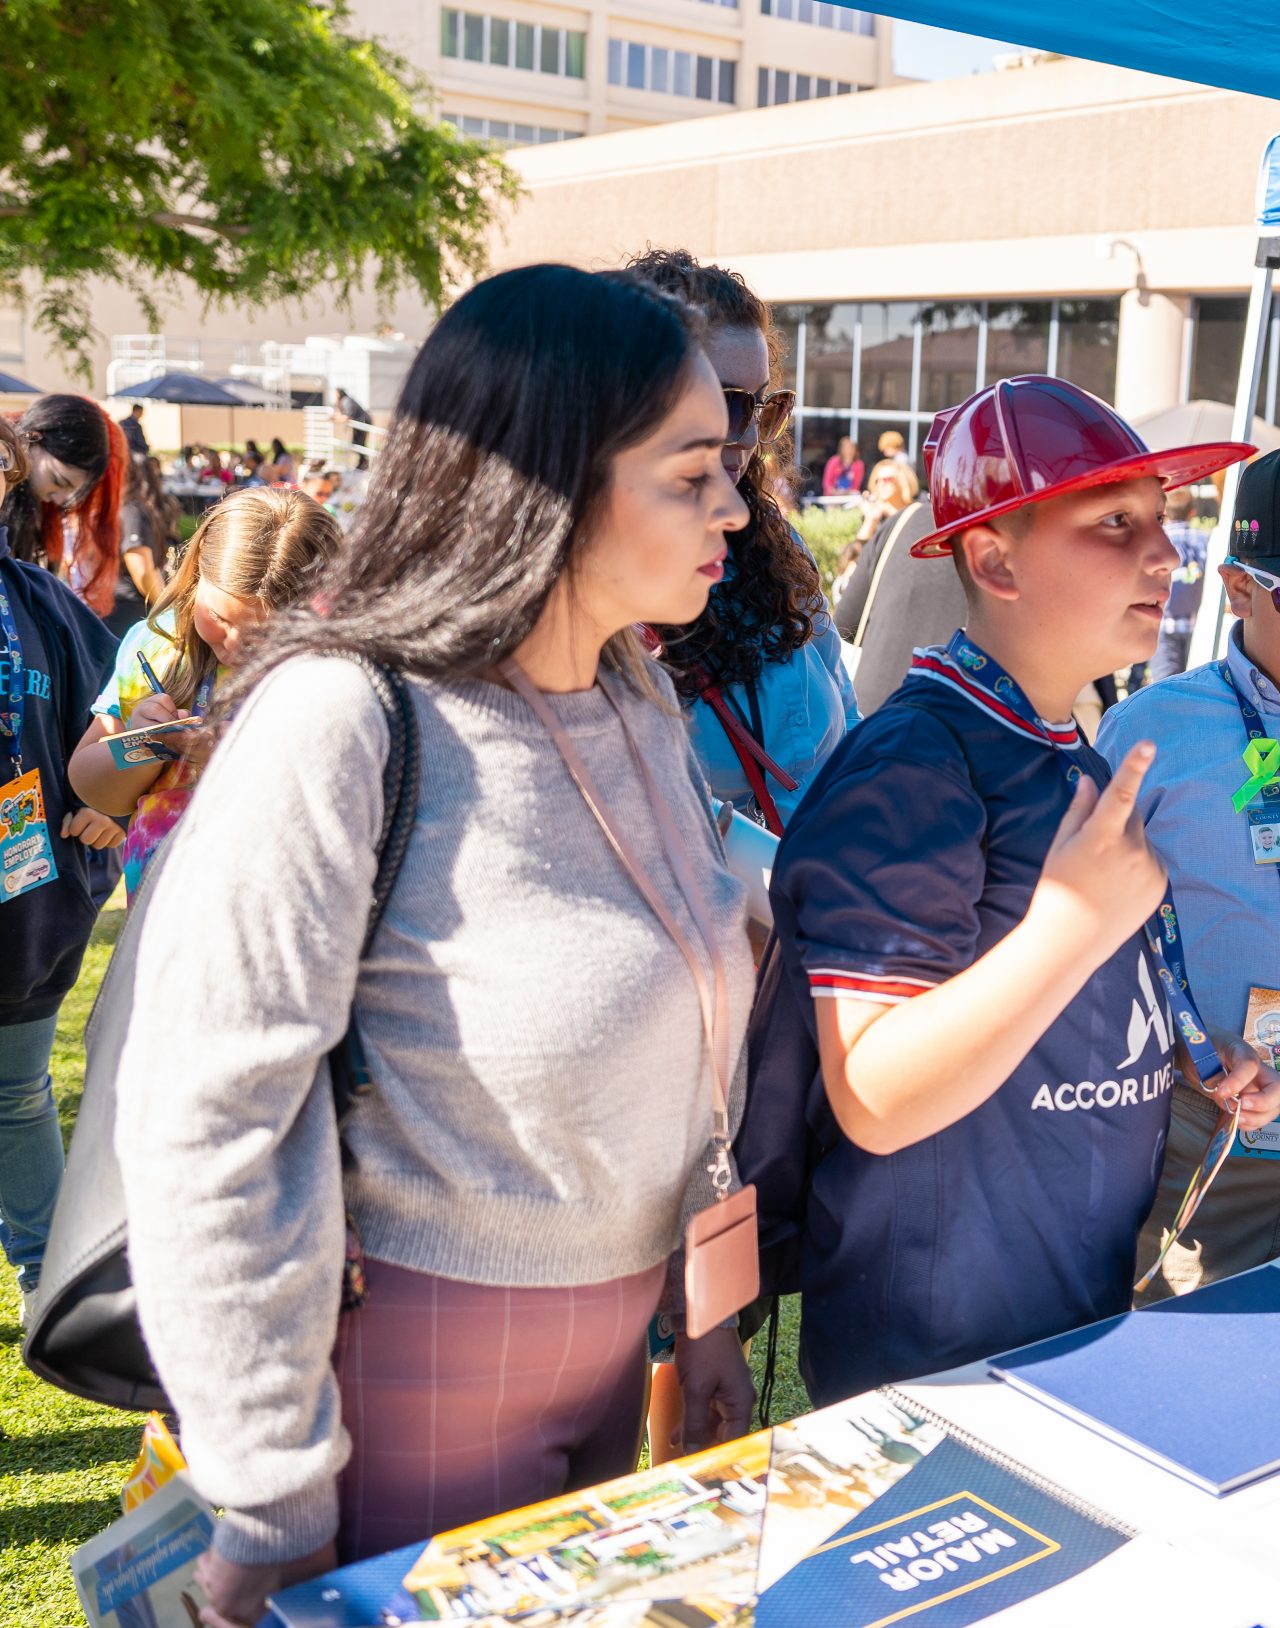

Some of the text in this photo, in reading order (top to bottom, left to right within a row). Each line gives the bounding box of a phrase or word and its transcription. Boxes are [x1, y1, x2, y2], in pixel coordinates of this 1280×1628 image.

[0, 661, 51, 700] FRE
[4, 844, 44, 869] EMPLOYEE
[1031, 1078, 1138, 1112] ACCOR
[1143, 1062, 1172, 1102] LIVE
[850, 1511, 989, 1570] RETAIL
[879, 1528, 1017, 1591] MAJOR
